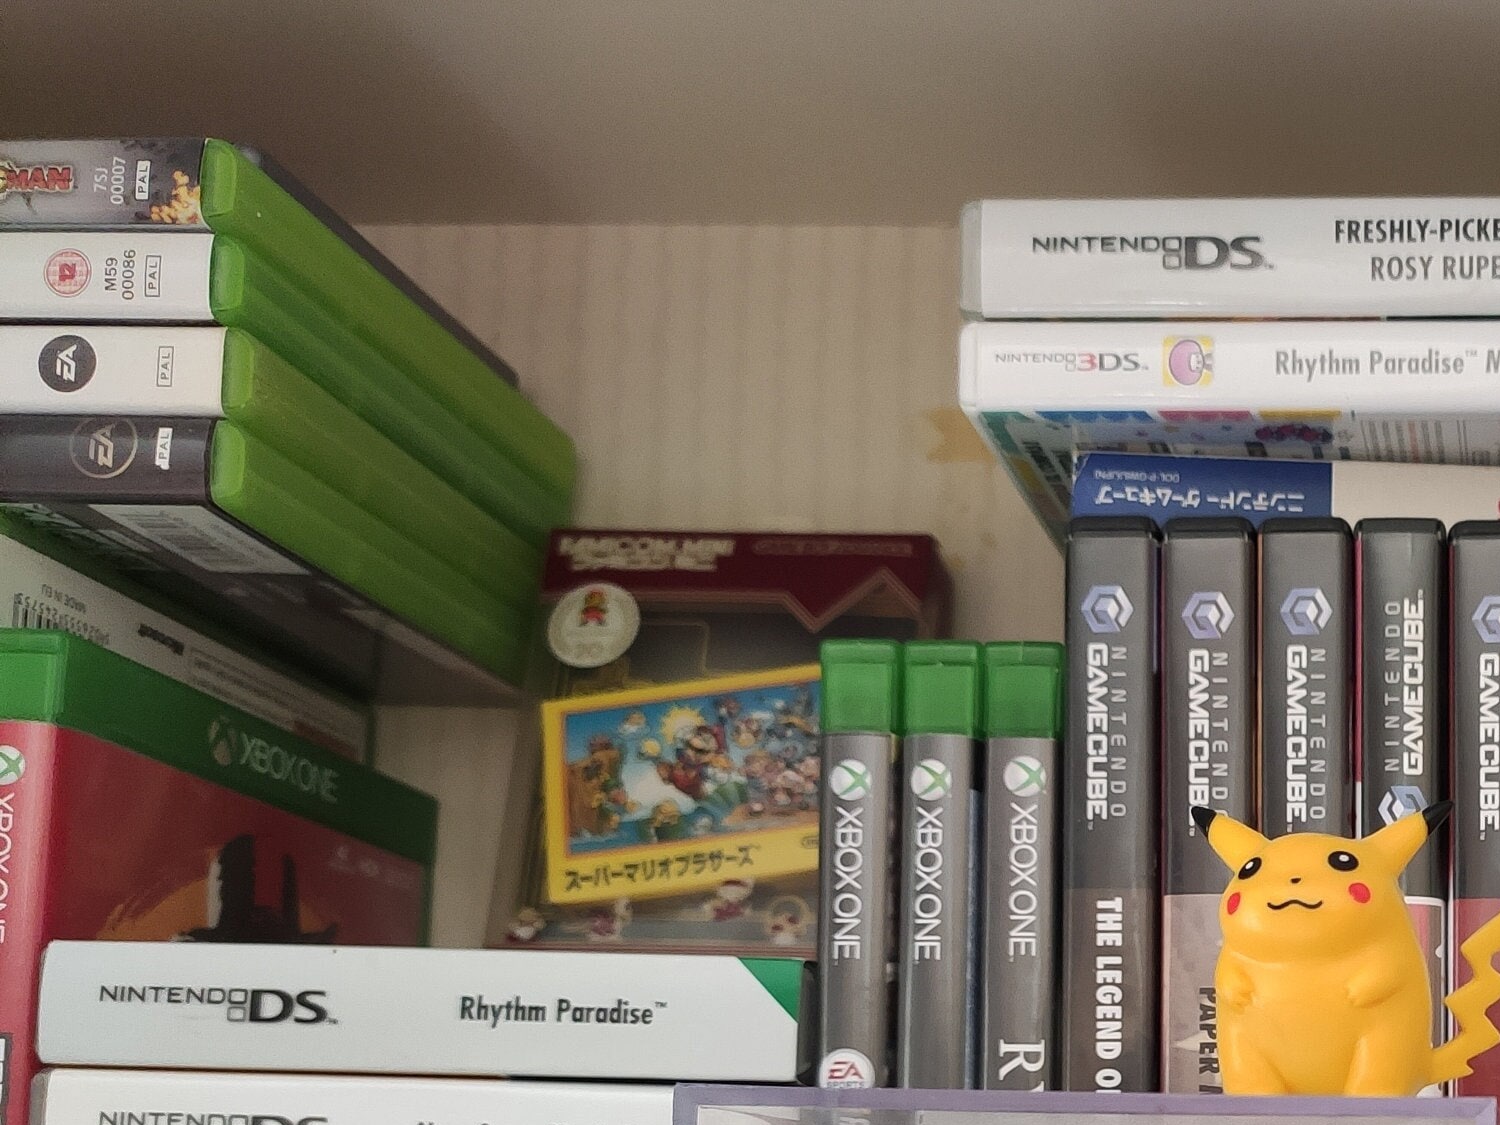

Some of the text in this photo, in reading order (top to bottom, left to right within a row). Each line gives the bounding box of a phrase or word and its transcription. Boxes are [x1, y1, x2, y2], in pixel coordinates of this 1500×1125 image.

[110, 157, 126, 204] 00007
[1032, 236, 1181, 253] NINTENDO
[105, 258, 117, 292] M59
[123, 249, 135, 299] 00086
[1371, 255, 1435, 281] ROSY
[56, 343, 77, 381] EA
[1275, 351, 1362, 379] Rhythm
[1087, 643, 1108, 820] GAMECUBE
[1112, 646, 1126, 817] NINTENDO
[1287, 645, 1307, 822] GAMECUBE
[1311, 648, 1325, 819] NINTENDO
[1385, 602, 1400, 771] NINTENDO
[1403, 596, 1424, 776] GAMECUBE
[1480, 653, 1500, 832] GAMECUBE
[834, 807, 863, 961] XBOX ONE
[915, 807, 943, 961] XBOX ONE
[1008, 803, 1039, 957] XBOX ONE
[100, 985, 248, 1006] NINTENDO
[459, 997, 545, 1028] Rhythm
[1096, 897, 1123, 1060] THE LEGEND
